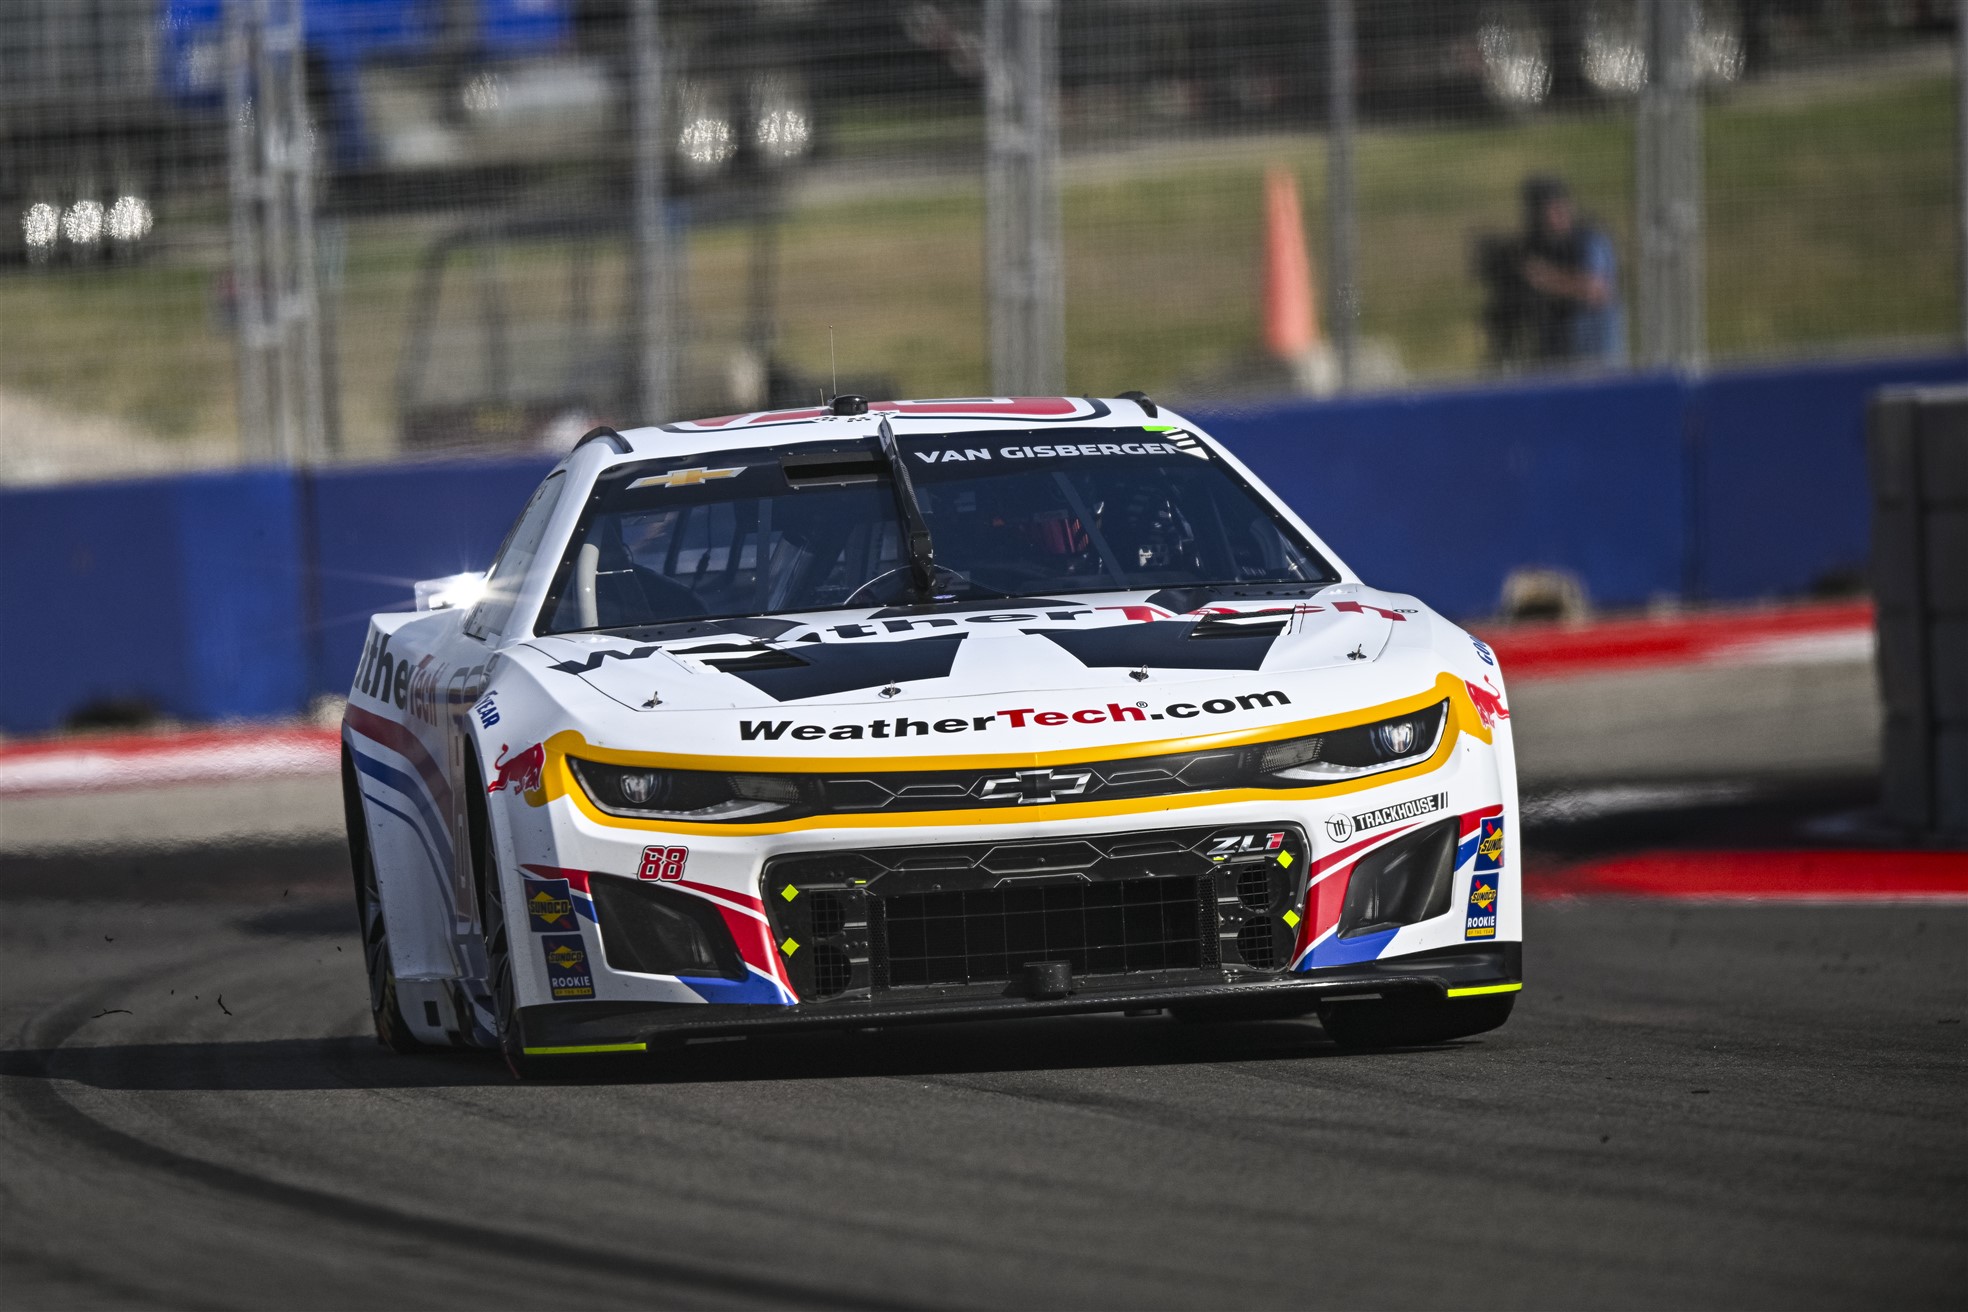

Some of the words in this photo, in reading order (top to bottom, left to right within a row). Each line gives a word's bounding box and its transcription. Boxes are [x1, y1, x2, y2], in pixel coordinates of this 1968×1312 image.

[914, 448, 992, 463] VAN
[1000, 443, 1183, 459] GISBERGEN
[1356, 796, 1437, 829] TRACKHOUSE
[1207, 832, 1285, 856] ZL1
[637, 845, 689, 882] 88
[1472, 890, 1496, 902] SUNOCO
[530, 900, 568, 913] SUNOCO
[1467, 915, 1495, 928] ROOKIE
[550, 952, 582, 961] SUNOCO
[552, 976, 591, 987] ROOKIE
